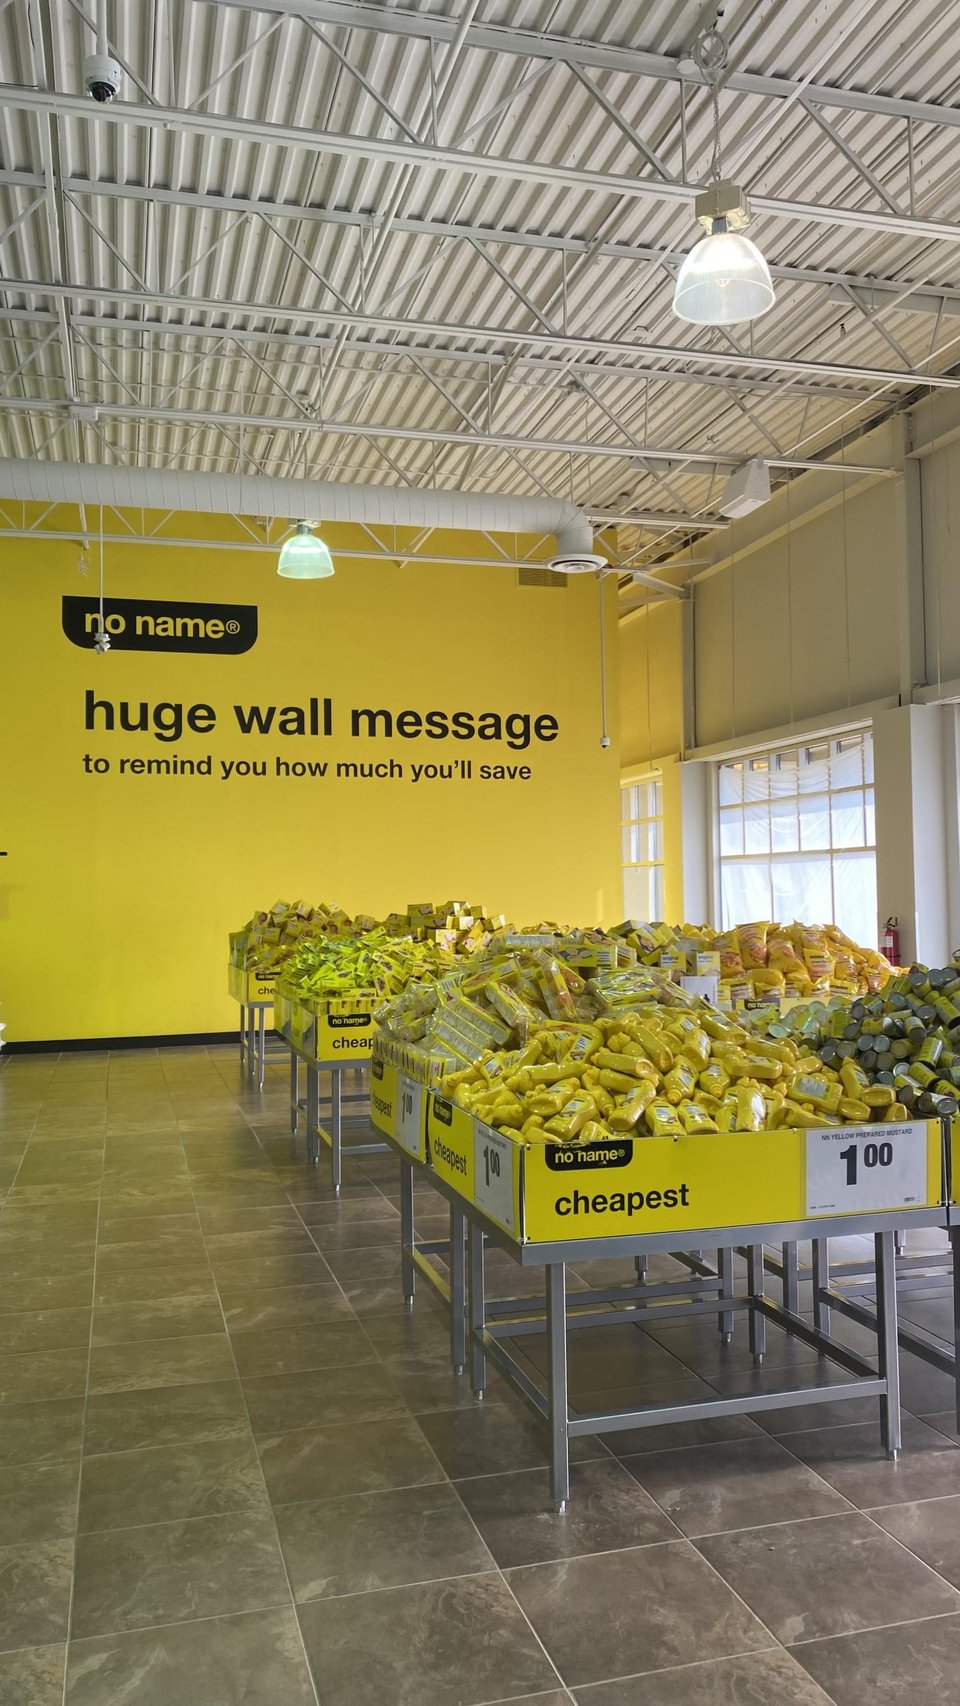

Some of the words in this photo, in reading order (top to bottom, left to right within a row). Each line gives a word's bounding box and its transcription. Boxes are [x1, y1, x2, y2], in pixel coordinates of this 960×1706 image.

[85, 612, 126, 635] no
[85, 689, 217, 742] huge
[233, 697, 332, 736] wall
[351, 708, 559, 750] message
[82, 753, 110, 774] to
[119, 754, 212, 775] remind
[220, 760, 267, 780] you
[276, 756, 328, 777] how
[336, 758, 402, 778] much
[479, 764, 532, 780] save
[332, 1036, 374, 1050] cheap
[831, 1132, 855, 1140] YELLOW
[855, 1130, 886, 1138] PREPARED
[887, 1128, 912, 1136] MUSTARD
[434, 1137, 467, 1177] cheapest
[555, 1151, 574, 1164] no
[555, 1184, 689, 1216] cheapest
